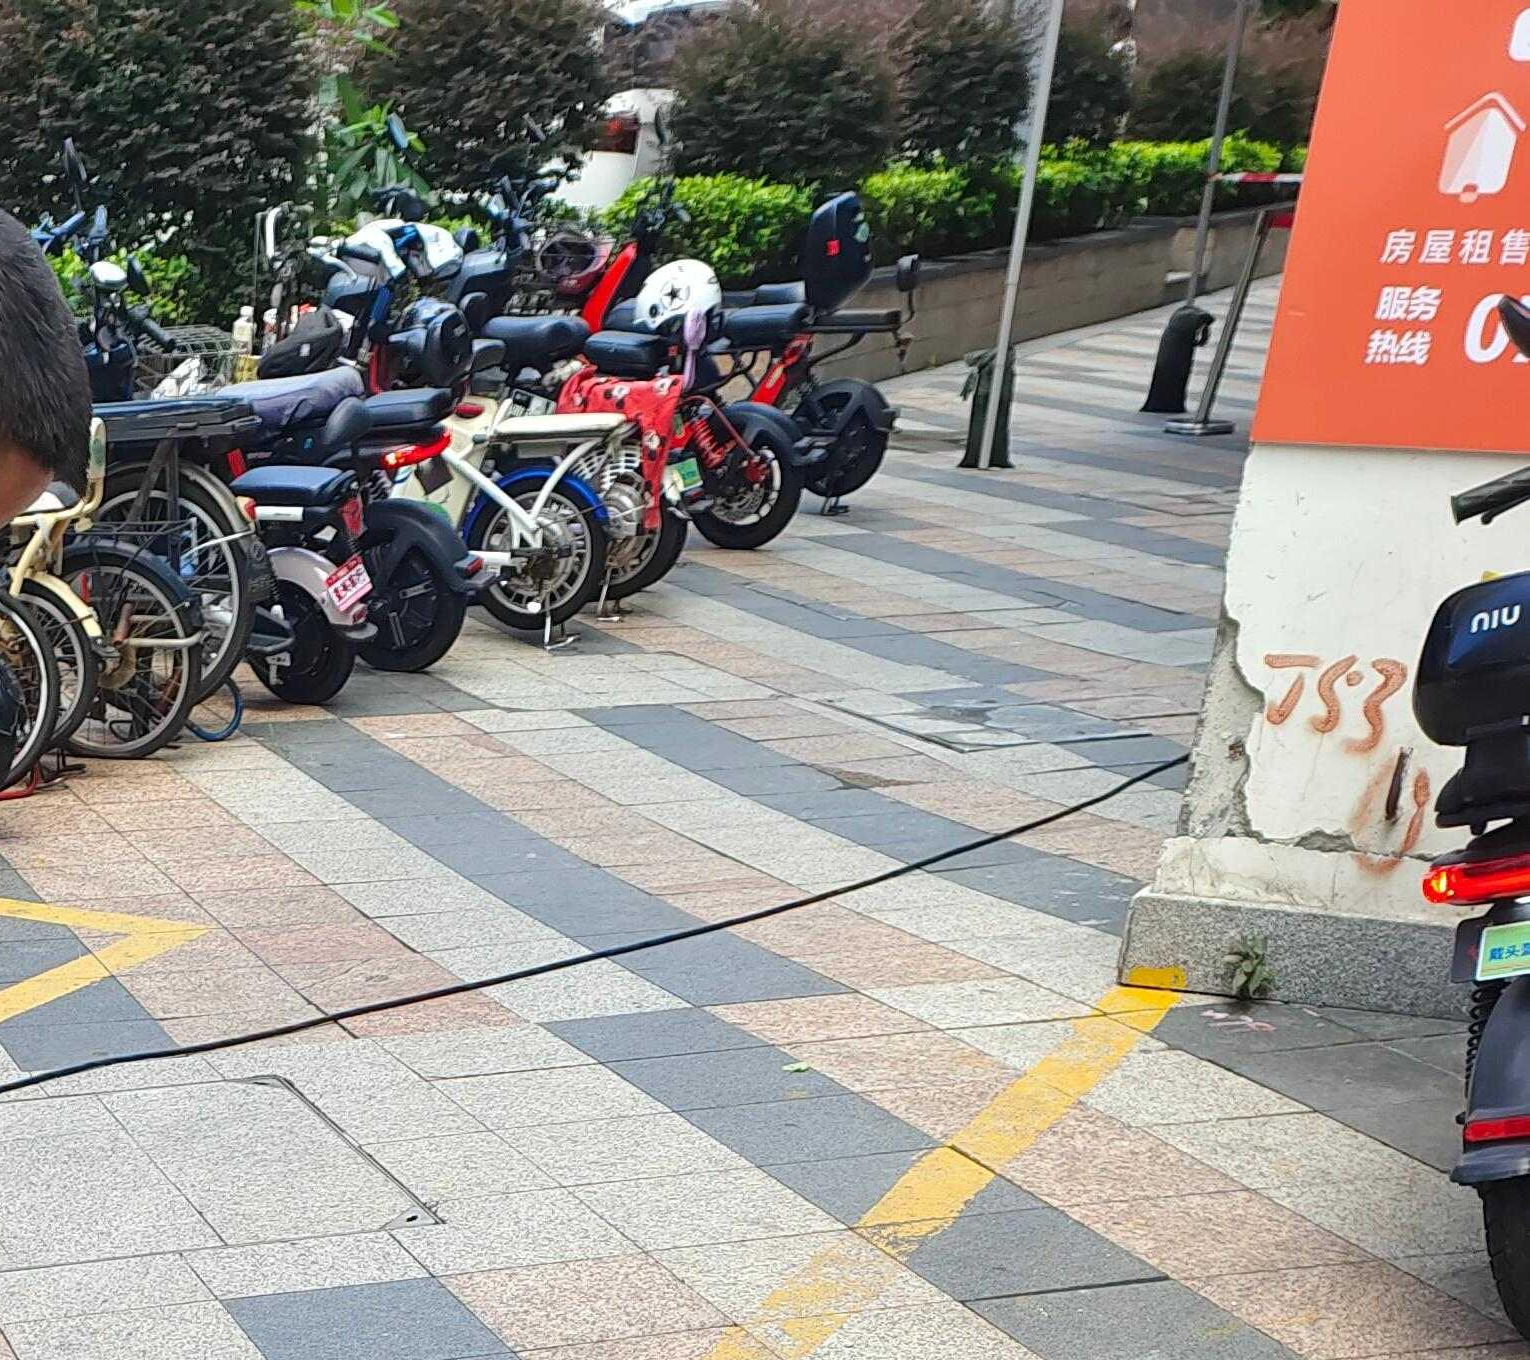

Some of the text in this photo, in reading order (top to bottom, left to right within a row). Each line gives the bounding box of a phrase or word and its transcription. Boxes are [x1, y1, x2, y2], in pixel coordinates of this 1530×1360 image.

[1379, 228, 1530, 265] 房屋租售
[1373, 285, 1442, 321] 服务
[1365, 328, 1432, 366] 热线
